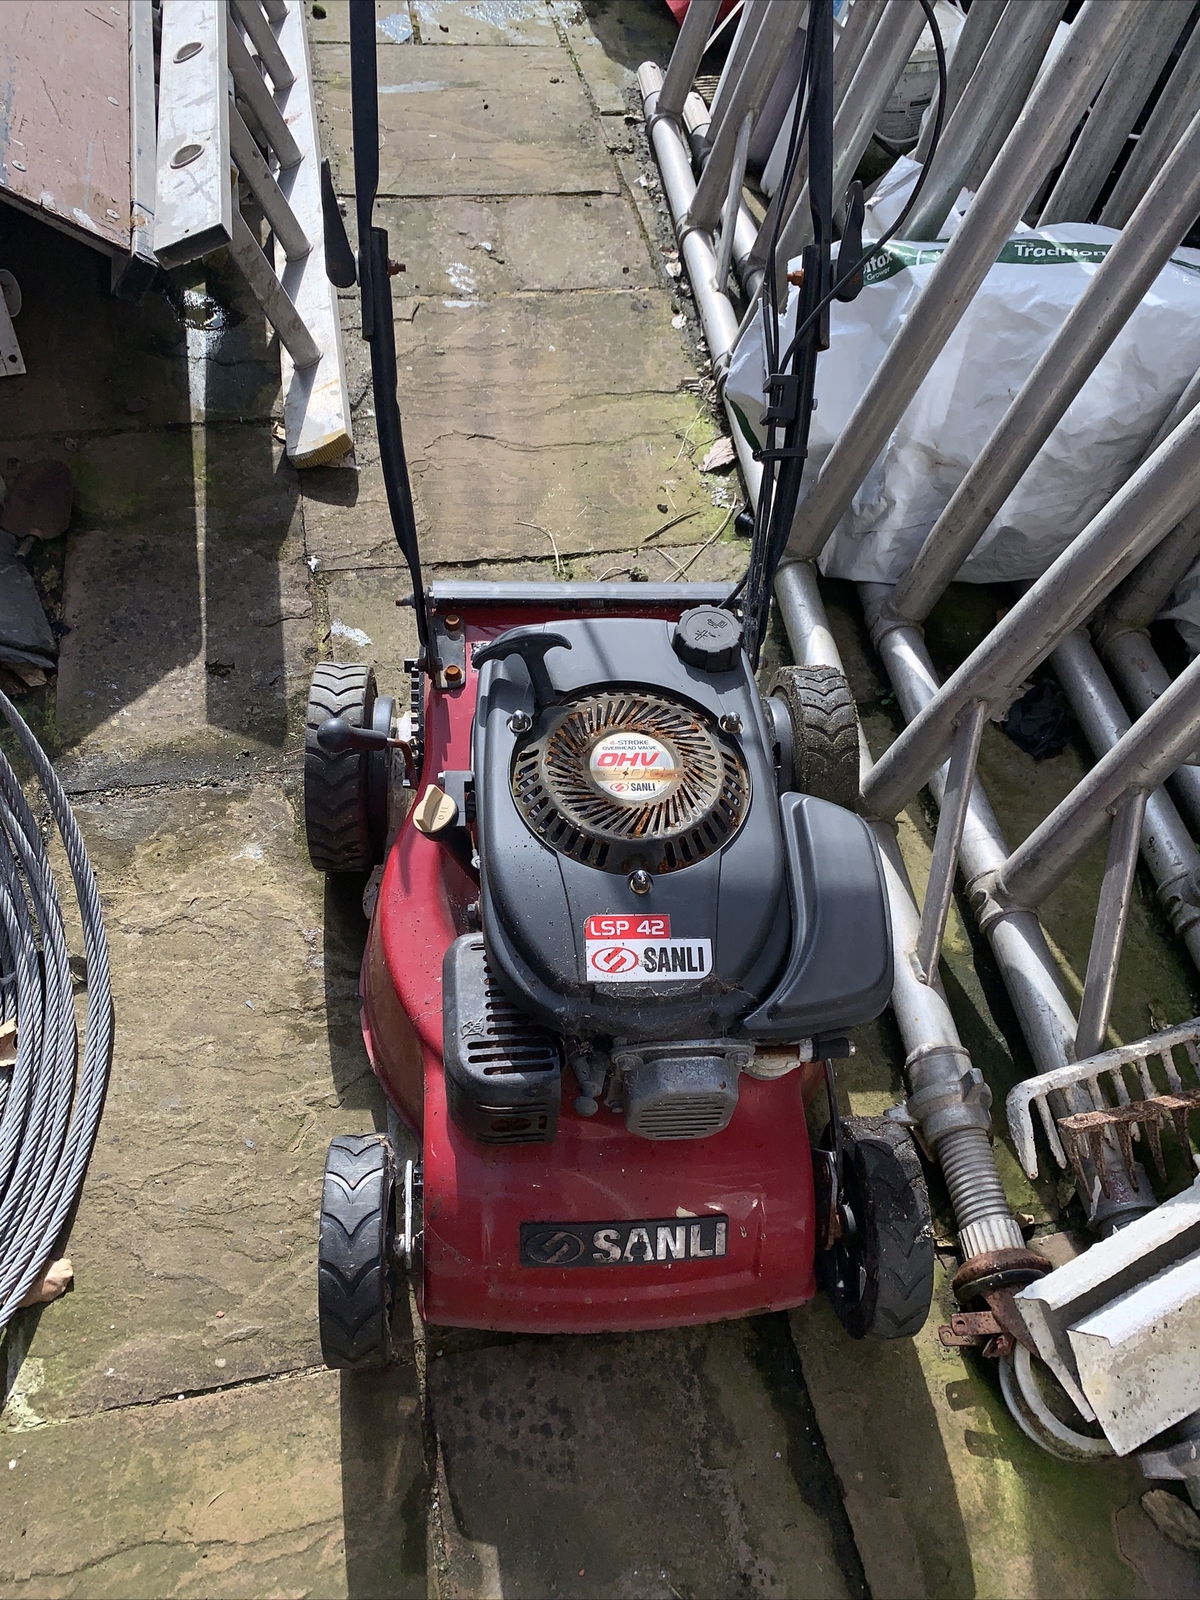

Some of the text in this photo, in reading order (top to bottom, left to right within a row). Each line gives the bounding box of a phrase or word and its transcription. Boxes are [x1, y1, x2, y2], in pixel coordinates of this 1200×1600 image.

[866, 266, 891, 281] Grower
[597, 752, 660, 766] OHV
[631, 782, 656, 791] SANLI
[437, 806, 448, 820] OIL
[590, 919, 665, 936] LSP 42
[643, 947, 704, 973] SANLI
[592, 1222, 726, 1263] SANLI
